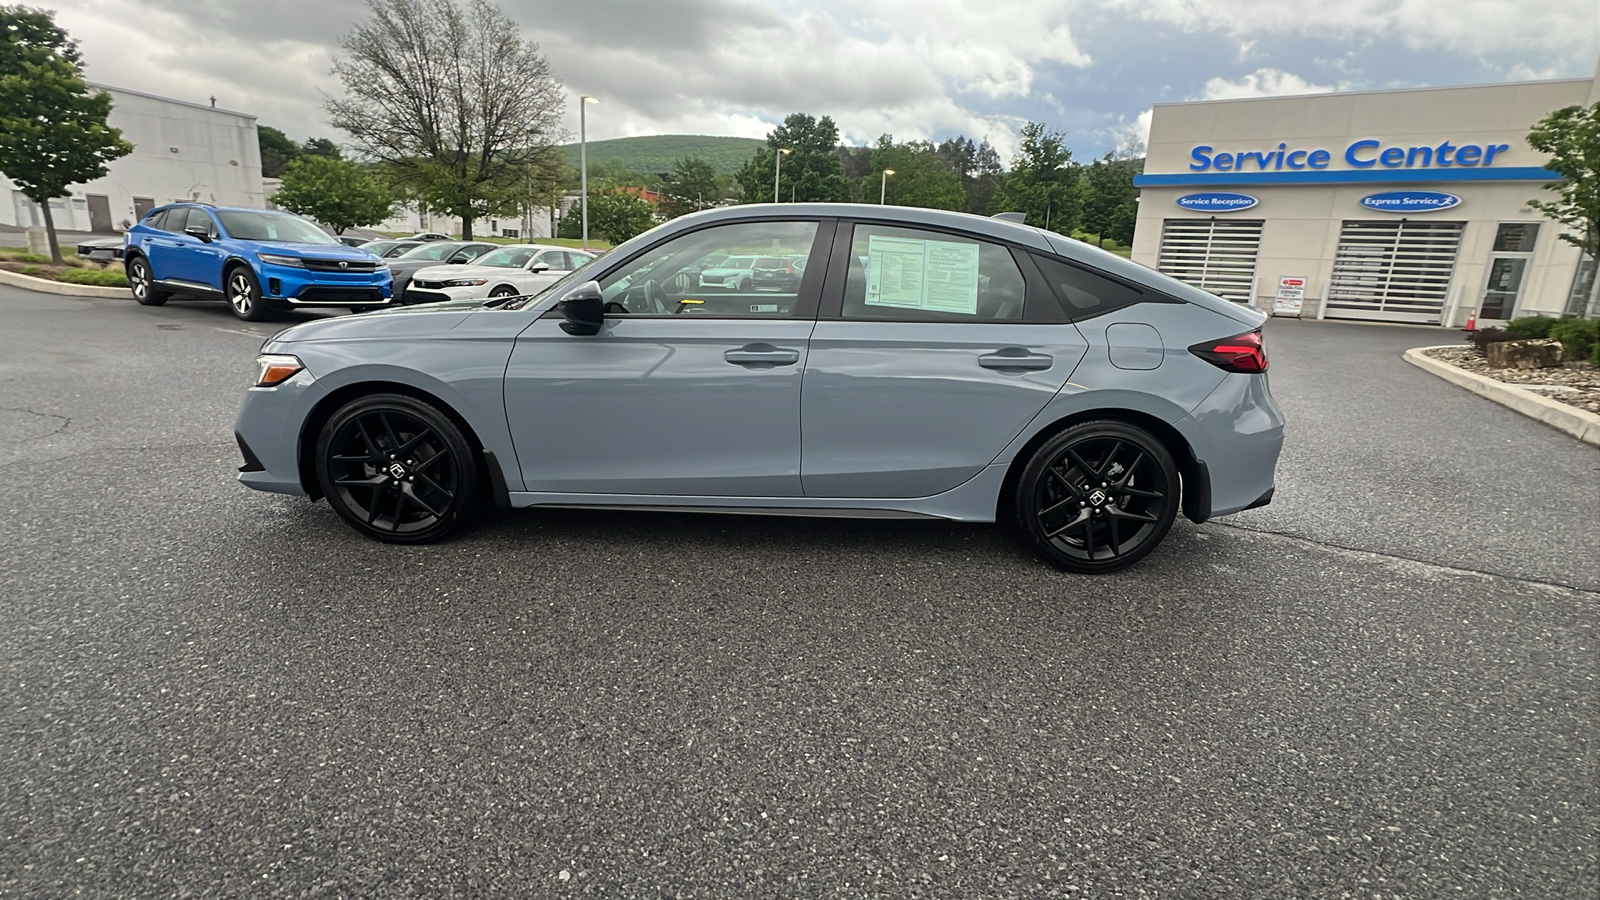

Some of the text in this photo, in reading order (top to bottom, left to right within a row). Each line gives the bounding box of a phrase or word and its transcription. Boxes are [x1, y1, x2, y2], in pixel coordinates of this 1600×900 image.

[1189, 139, 1510, 172] Service Center
[1180, 197, 1252, 207] Service Reception
[1364, 197, 1439, 206] Express Service
